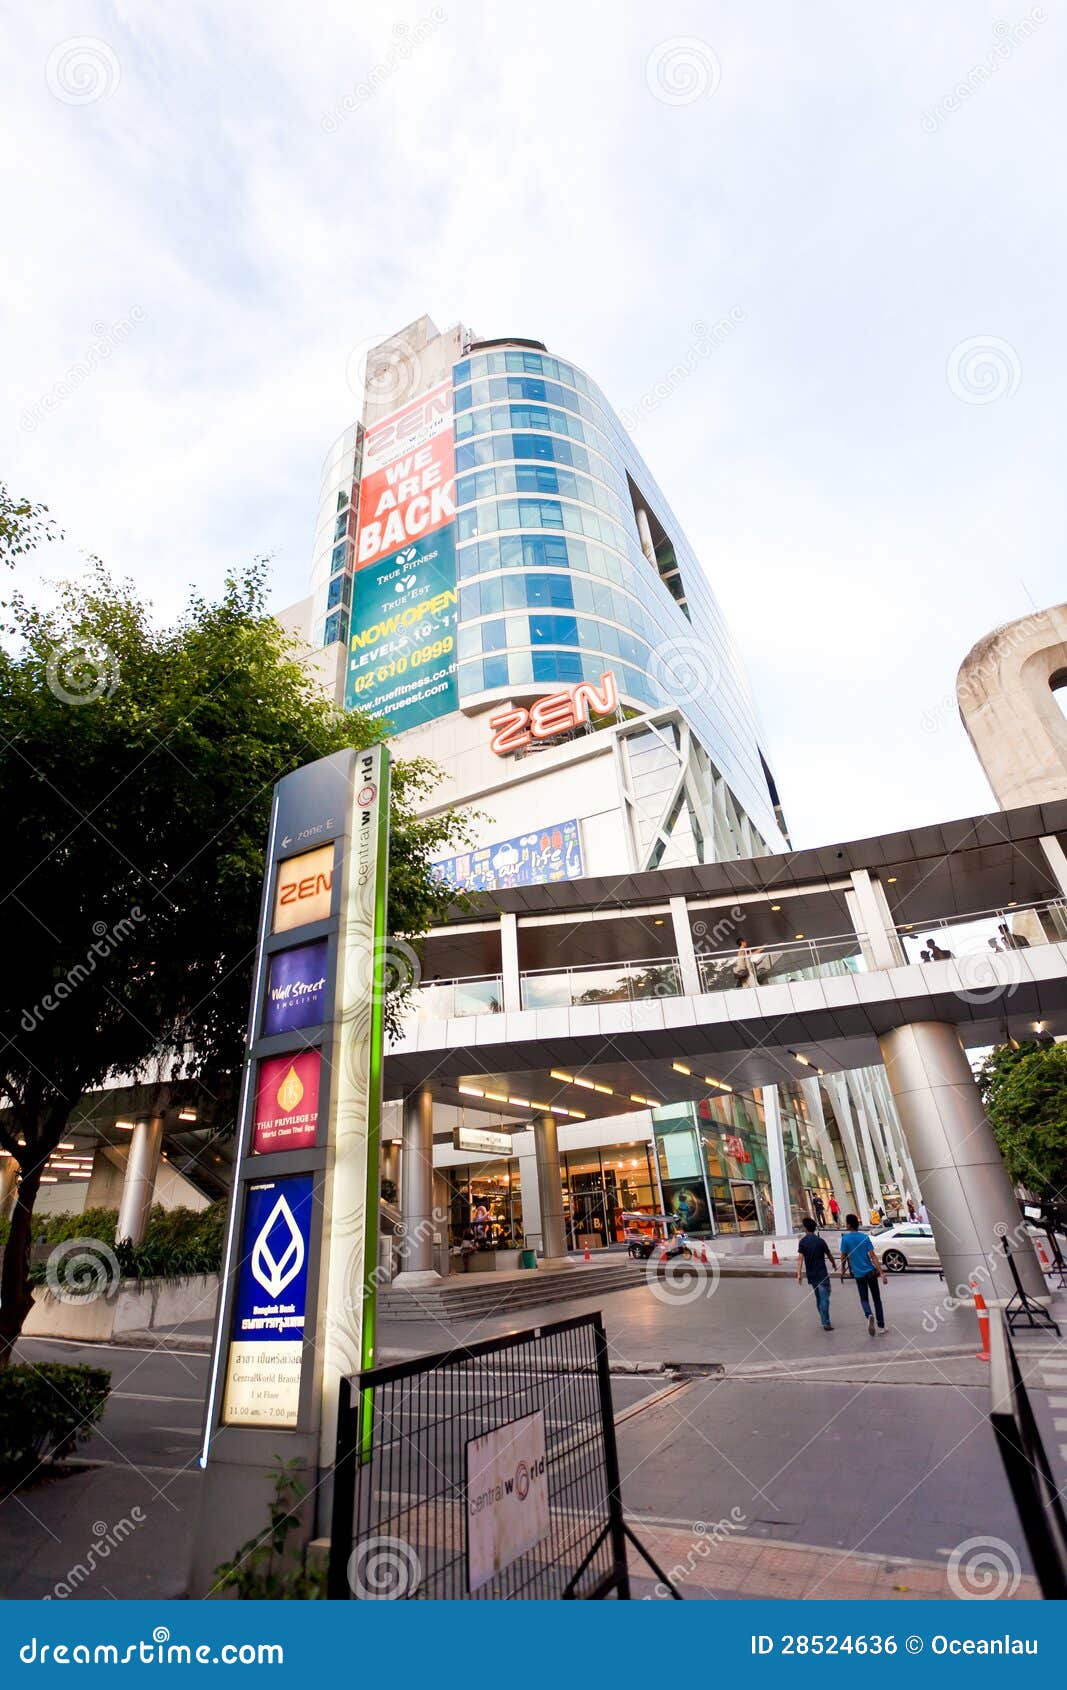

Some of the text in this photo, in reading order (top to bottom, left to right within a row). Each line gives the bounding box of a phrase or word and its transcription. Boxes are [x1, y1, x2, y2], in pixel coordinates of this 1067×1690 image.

[385, 445, 432, 485] WE
[375, 462, 441, 518] ARE
[357, 479, 456, 563] BACK
[350, 636, 408, 671] LEVELS
[354, 635, 454, 694] 02 610 0999
[489, 671, 618, 755] ZEN
[297, 818, 335, 841] zone E
[357, 756, 378, 886] centralworld
[280, 869, 334, 906] ZEN
[272, 978, 326, 1000] Wall Street
[276, 995, 317, 1009] ENGLISH
[257, 1120, 273, 1130] THAI
[275, 1113, 309, 1127] PRIVILEGE
[232, 1372, 276, 1383] CentralWorld
[470, 1456, 546, 1516] centralworld
